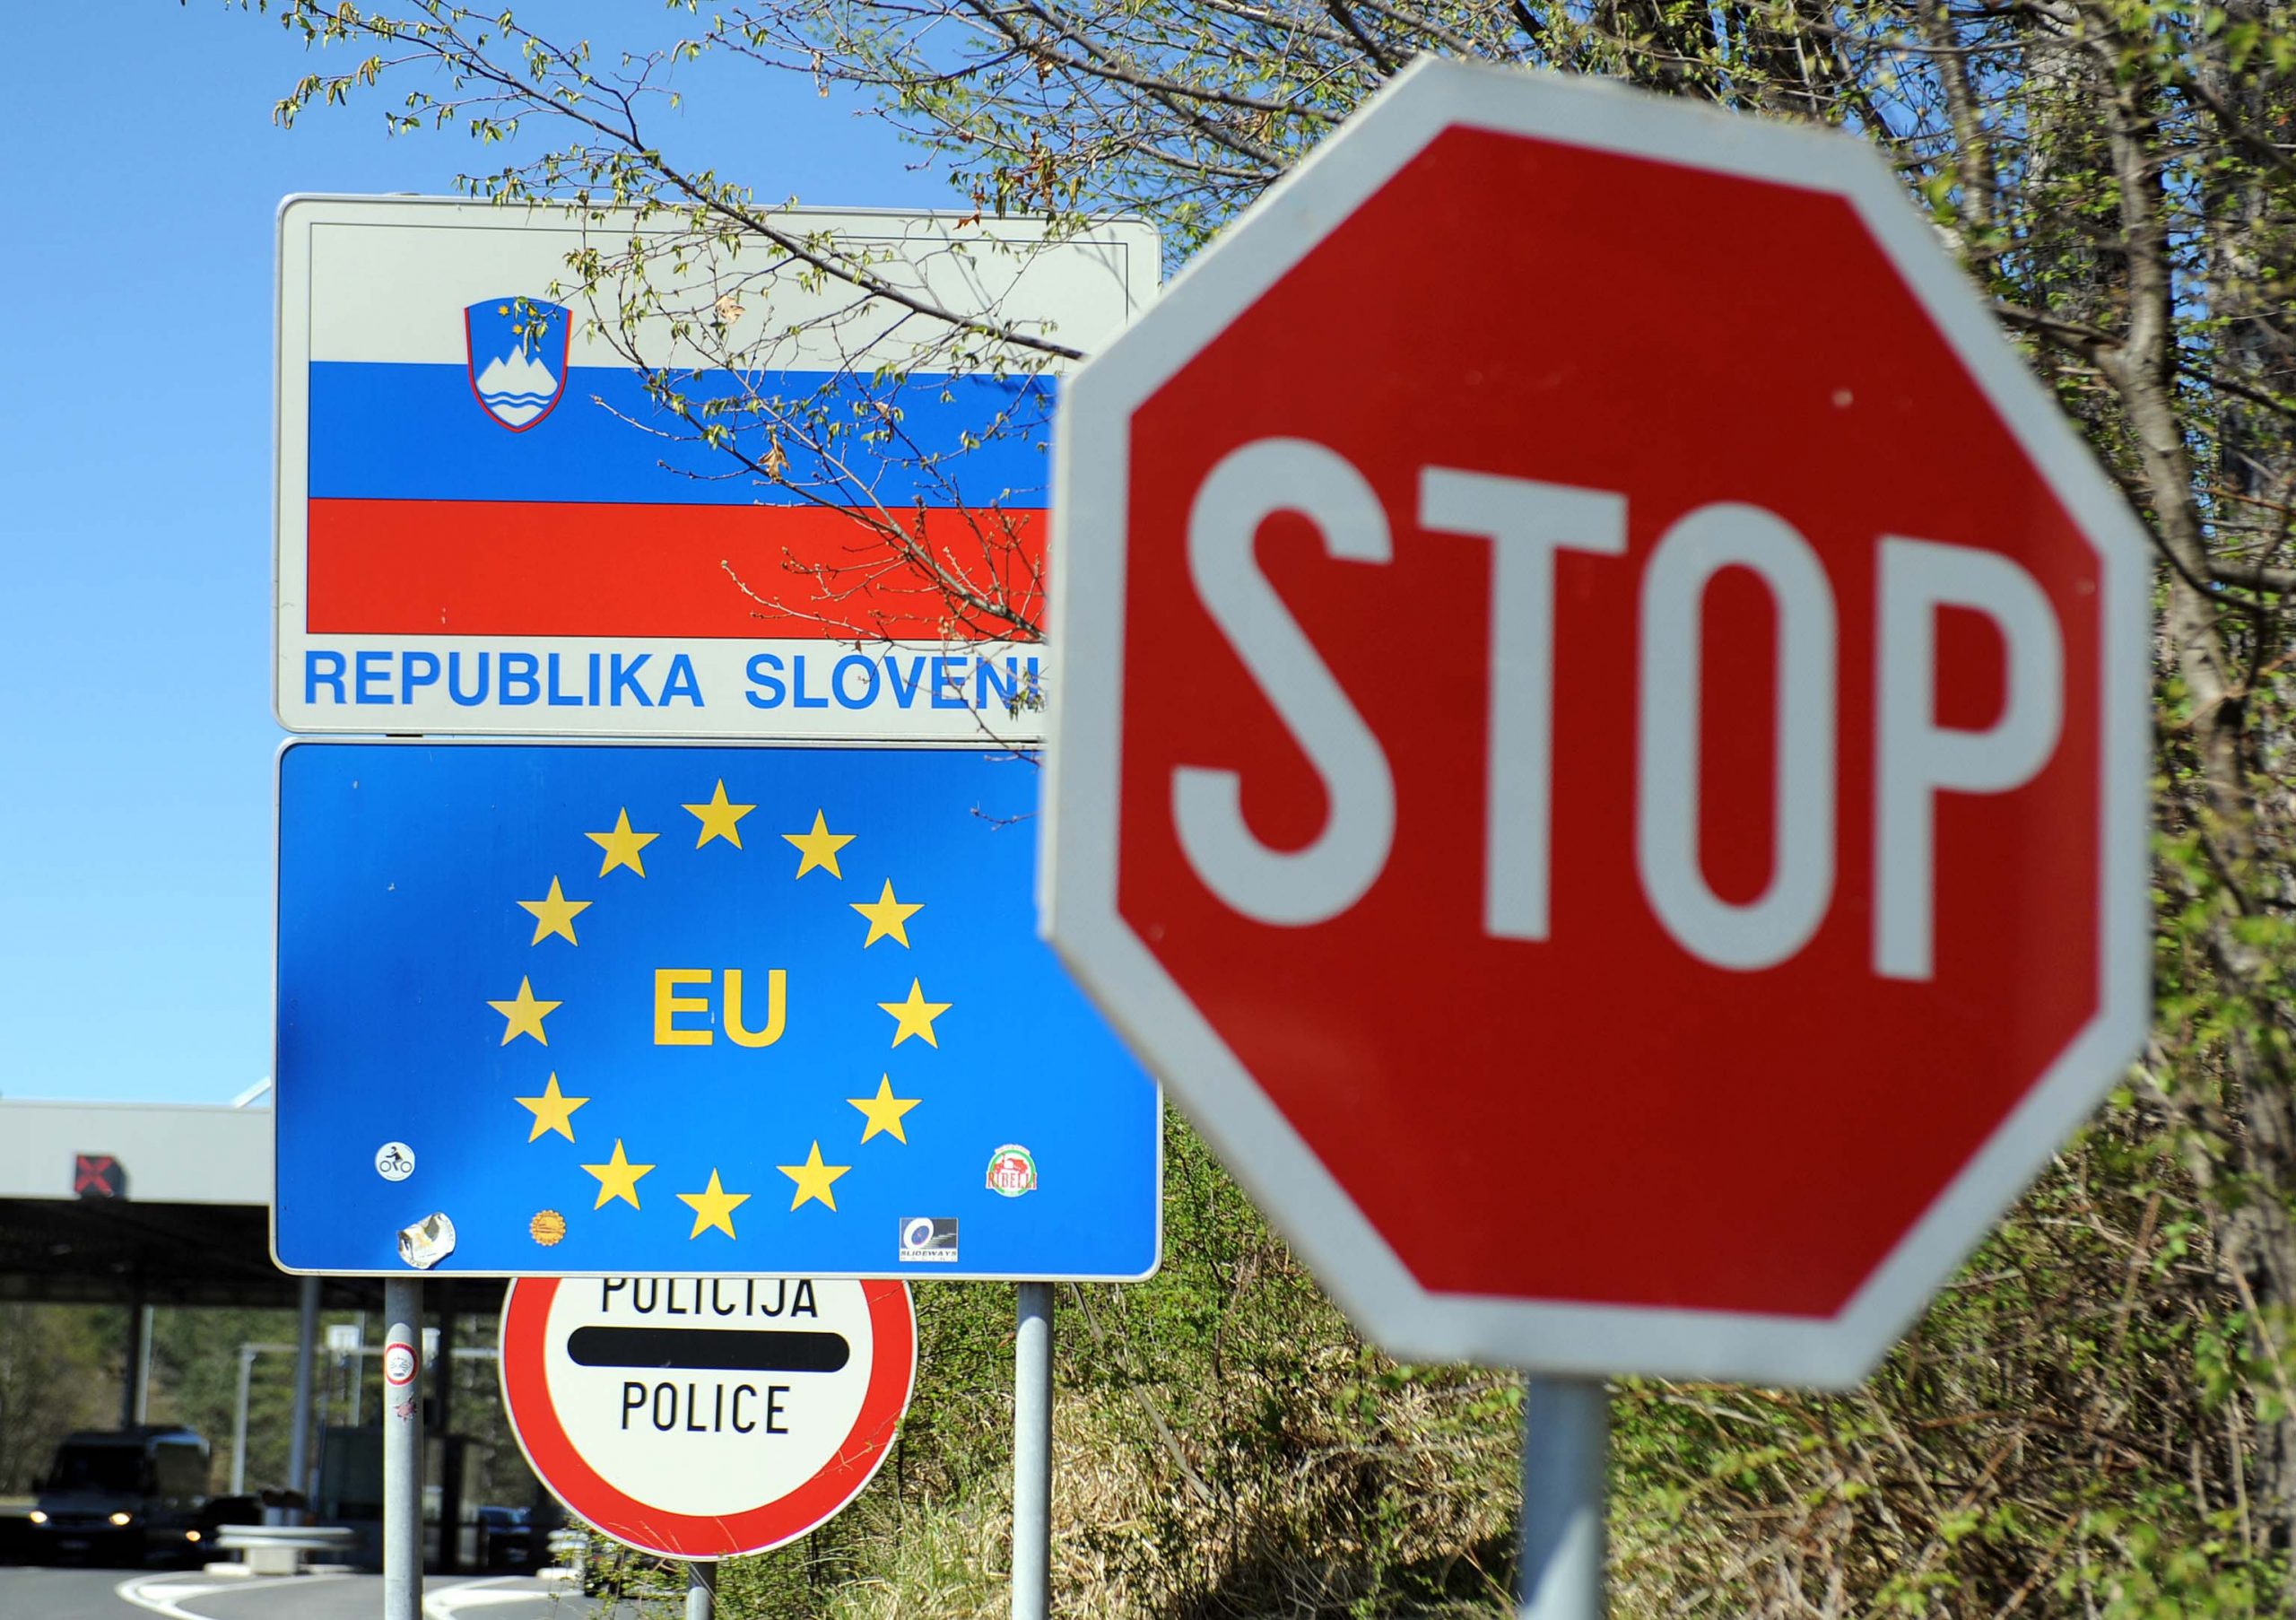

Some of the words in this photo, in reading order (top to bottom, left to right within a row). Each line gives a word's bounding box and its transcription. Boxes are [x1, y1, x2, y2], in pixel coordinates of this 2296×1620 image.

[304, 649, 706, 708] REPUBLIKA
[744, 652, 1048, 710] SLOVENI
[1171, 437, 2065, 981] STOP
[654, 969, 787, 1048] EU
[601, 1279, 818, 1318] POLICIJA
[621, 1381, 792, 1435] POLICE
